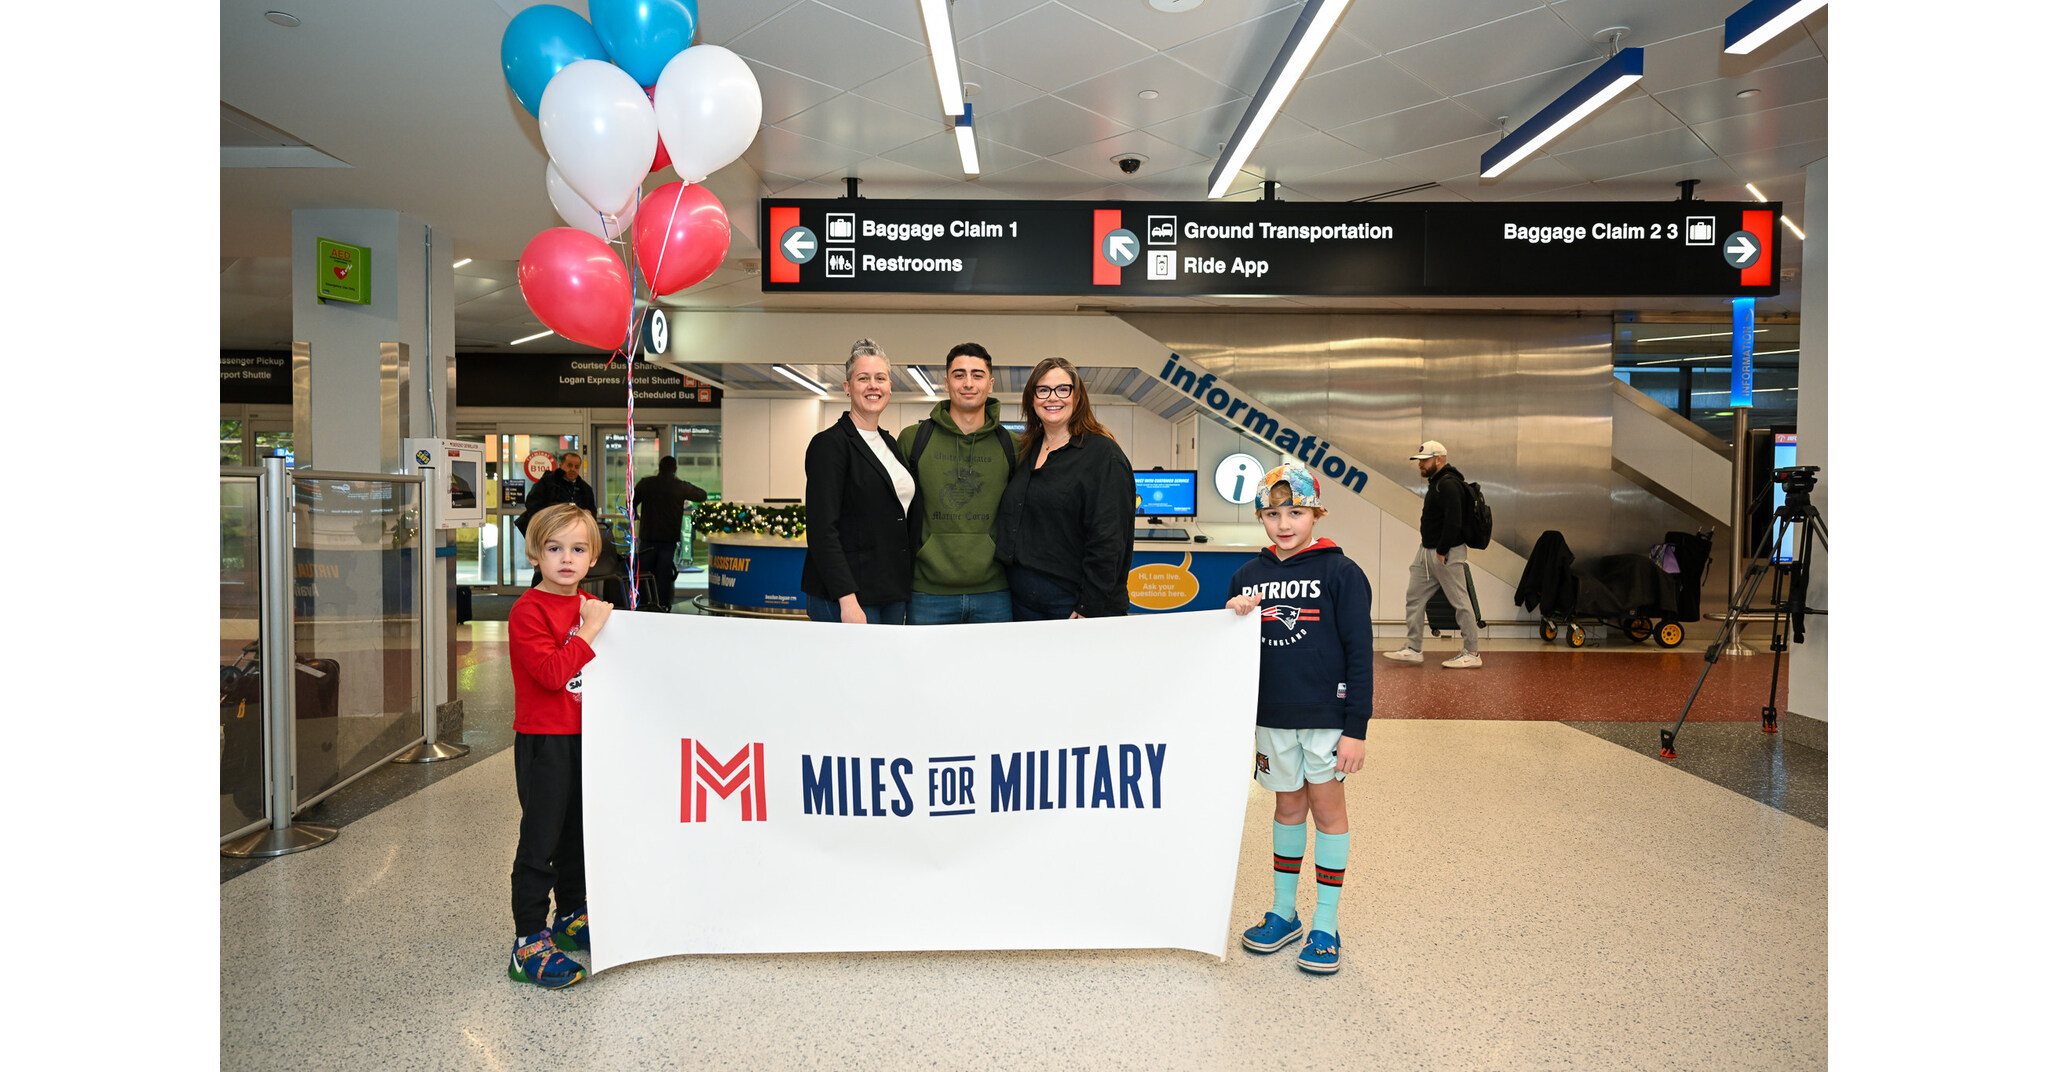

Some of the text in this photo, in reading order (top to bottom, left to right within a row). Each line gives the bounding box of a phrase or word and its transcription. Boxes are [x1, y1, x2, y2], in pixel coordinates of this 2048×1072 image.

[862, 220, 1018, 241] Baggage Claim 1
[1184, 222, 1393, 243] Ground Transportation
[1504, 223, 1679, 244] Baggage Claim 2 3
[331, 248, 351, 260] AED
[862, 255, 963, 272] Restrooms
[1184, 257, 1269, 278] Ride App
[256, 357, 285, 367] Pickup
[571, 361, 608, 371] Courtsey
[610, 361, 627, 370] Bus
[1741, 326, 1752, 397] INFORMATION
[220, 370, 272, 380] rport Shuttle
[559, 376, 584, 385] Logan
[587, 376, 620, 385] Express
[651, 376, 681, 384] Shuttle
[633, 390, 695, 399] Scheduled Bus
[1160, 352, 1369, 494] information
[714, 555, 751, 572] ASSISTANT
[721, 573, 736, 588] Now
[1158, 584, 1175, 592] your
[1131, 590, 1167, 598] questions
[1242, 580, 1321, 600] PATRIOTS
[1268, 629, 1307, 647] ENGLAND
[801, 743, 1167, 817] MILES FOR MILITARY
